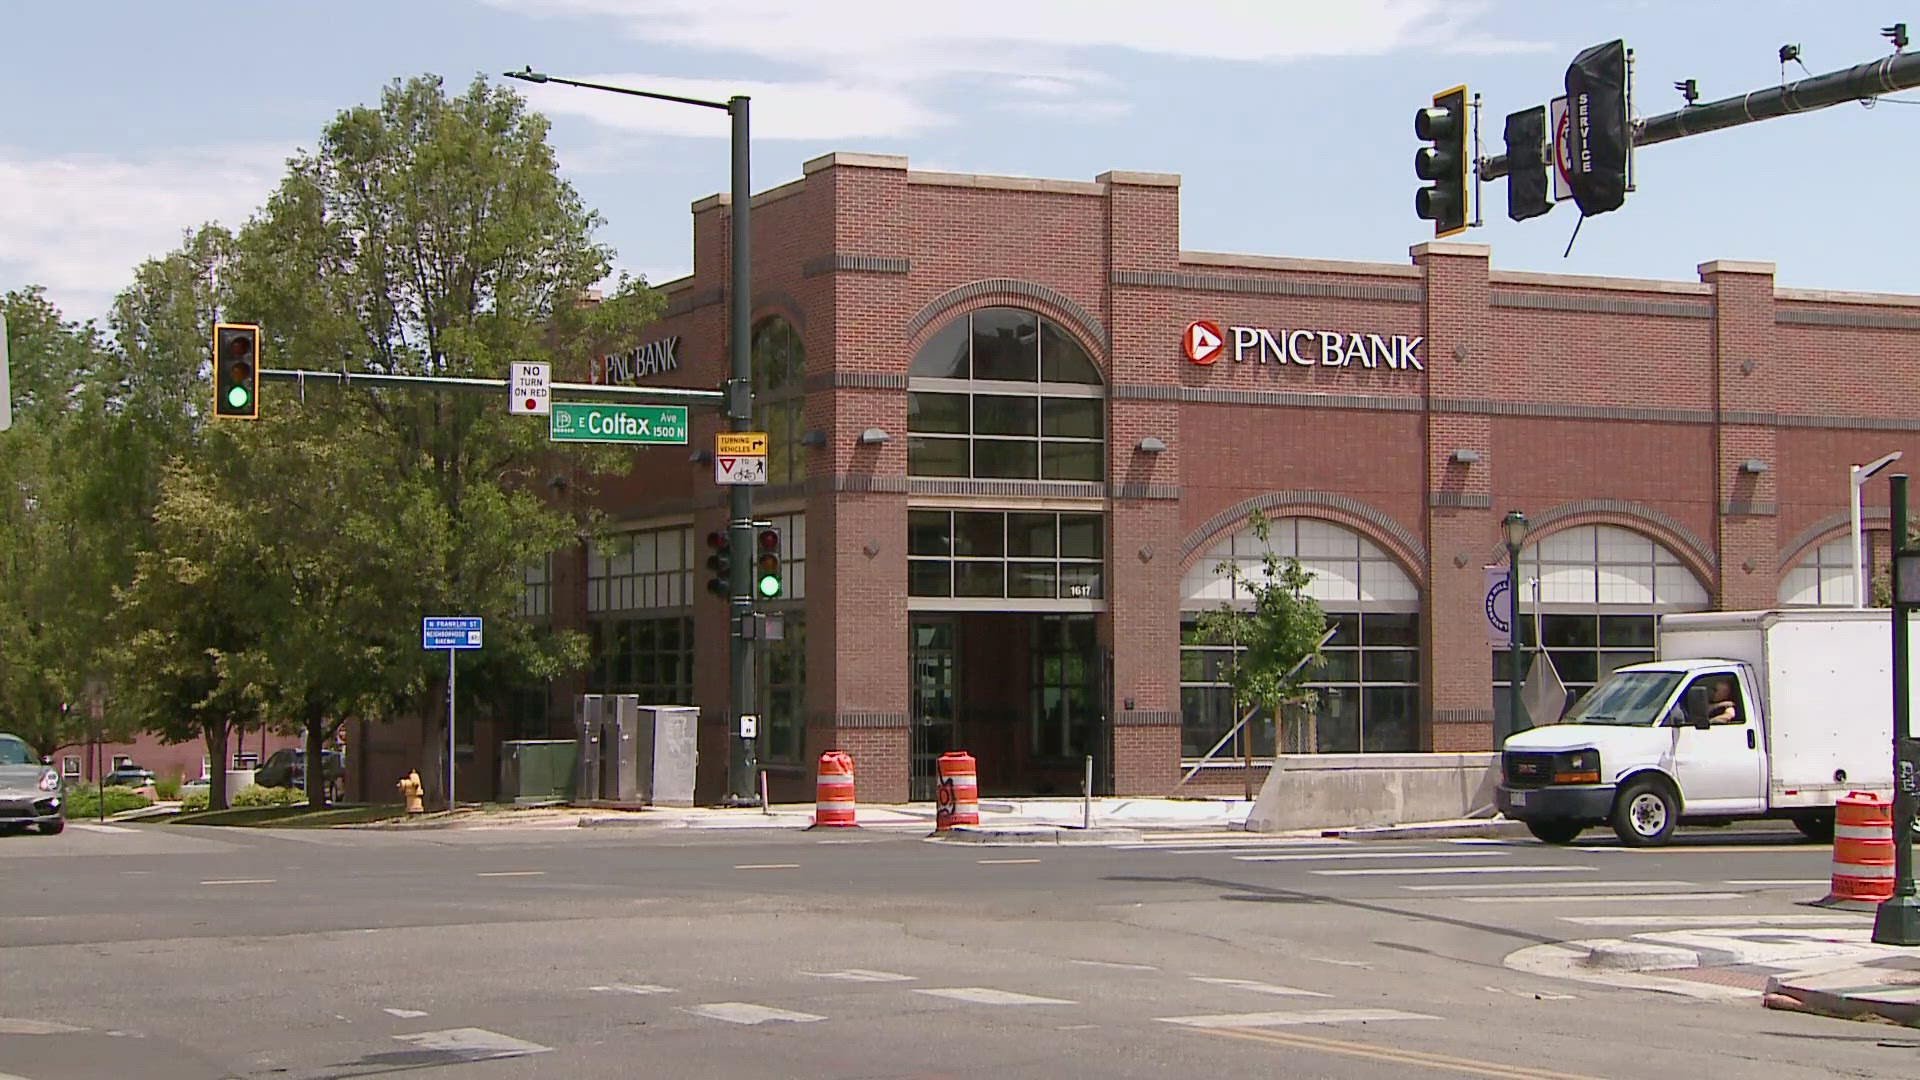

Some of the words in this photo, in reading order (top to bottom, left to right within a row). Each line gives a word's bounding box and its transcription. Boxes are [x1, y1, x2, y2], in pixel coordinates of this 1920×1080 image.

[1579, 93, 1592, 173] SERVICE
[523, 366, 540, 376] NO
[520, 378, 543, 386] TURN
[514, 388, 529, 396] ON
[530, 389, 547, 397] RED
[579, 417, 585, 428] E
[588, 411, 650, 435] Colfax
[660, 412, 677, 424] Ave
[653, 426, 675, 438] 1500
[677, 427, 684, 438] N
[1070, 586, 1091, 597] 1617
